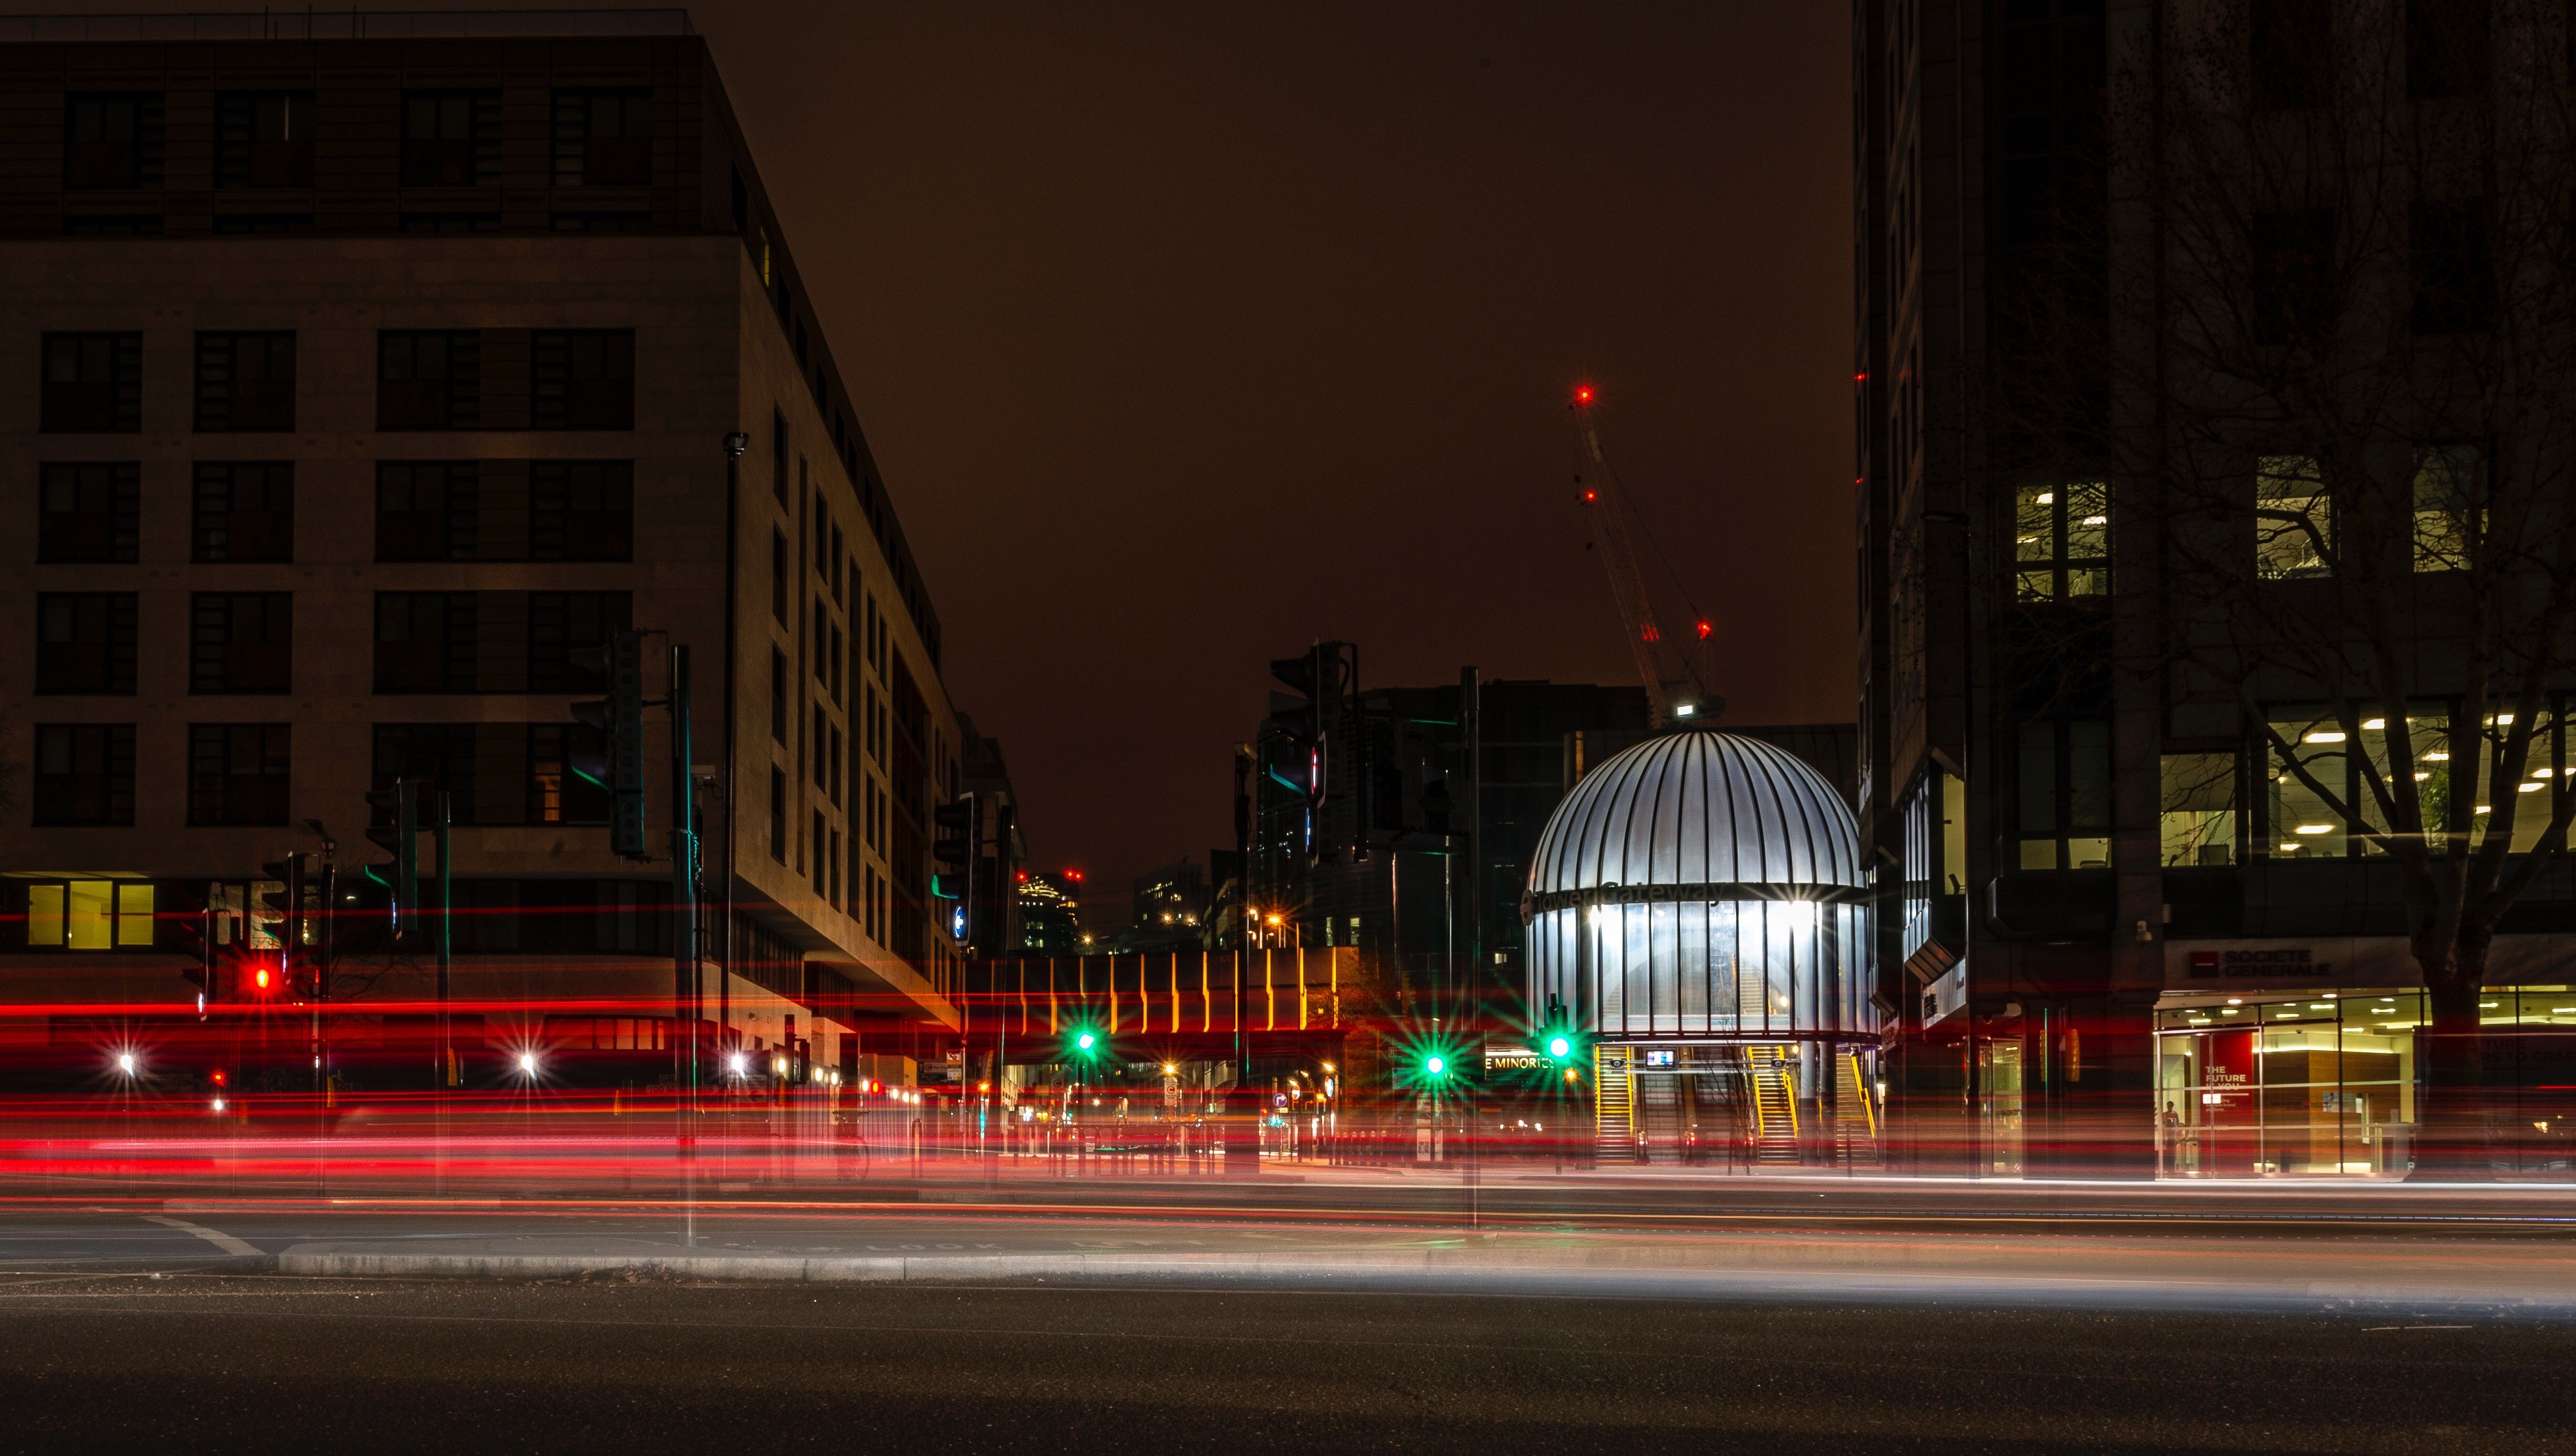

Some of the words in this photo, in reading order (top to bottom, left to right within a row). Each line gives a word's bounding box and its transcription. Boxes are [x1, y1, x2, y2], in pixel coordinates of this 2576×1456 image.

[1534, 889, 1592, 913] Tower
[1601, 881, 1727, 907] Gateway
[2226, 950, 2312, 962] SOCIETE
[2226, 964, 2331, 976] GENERALE
